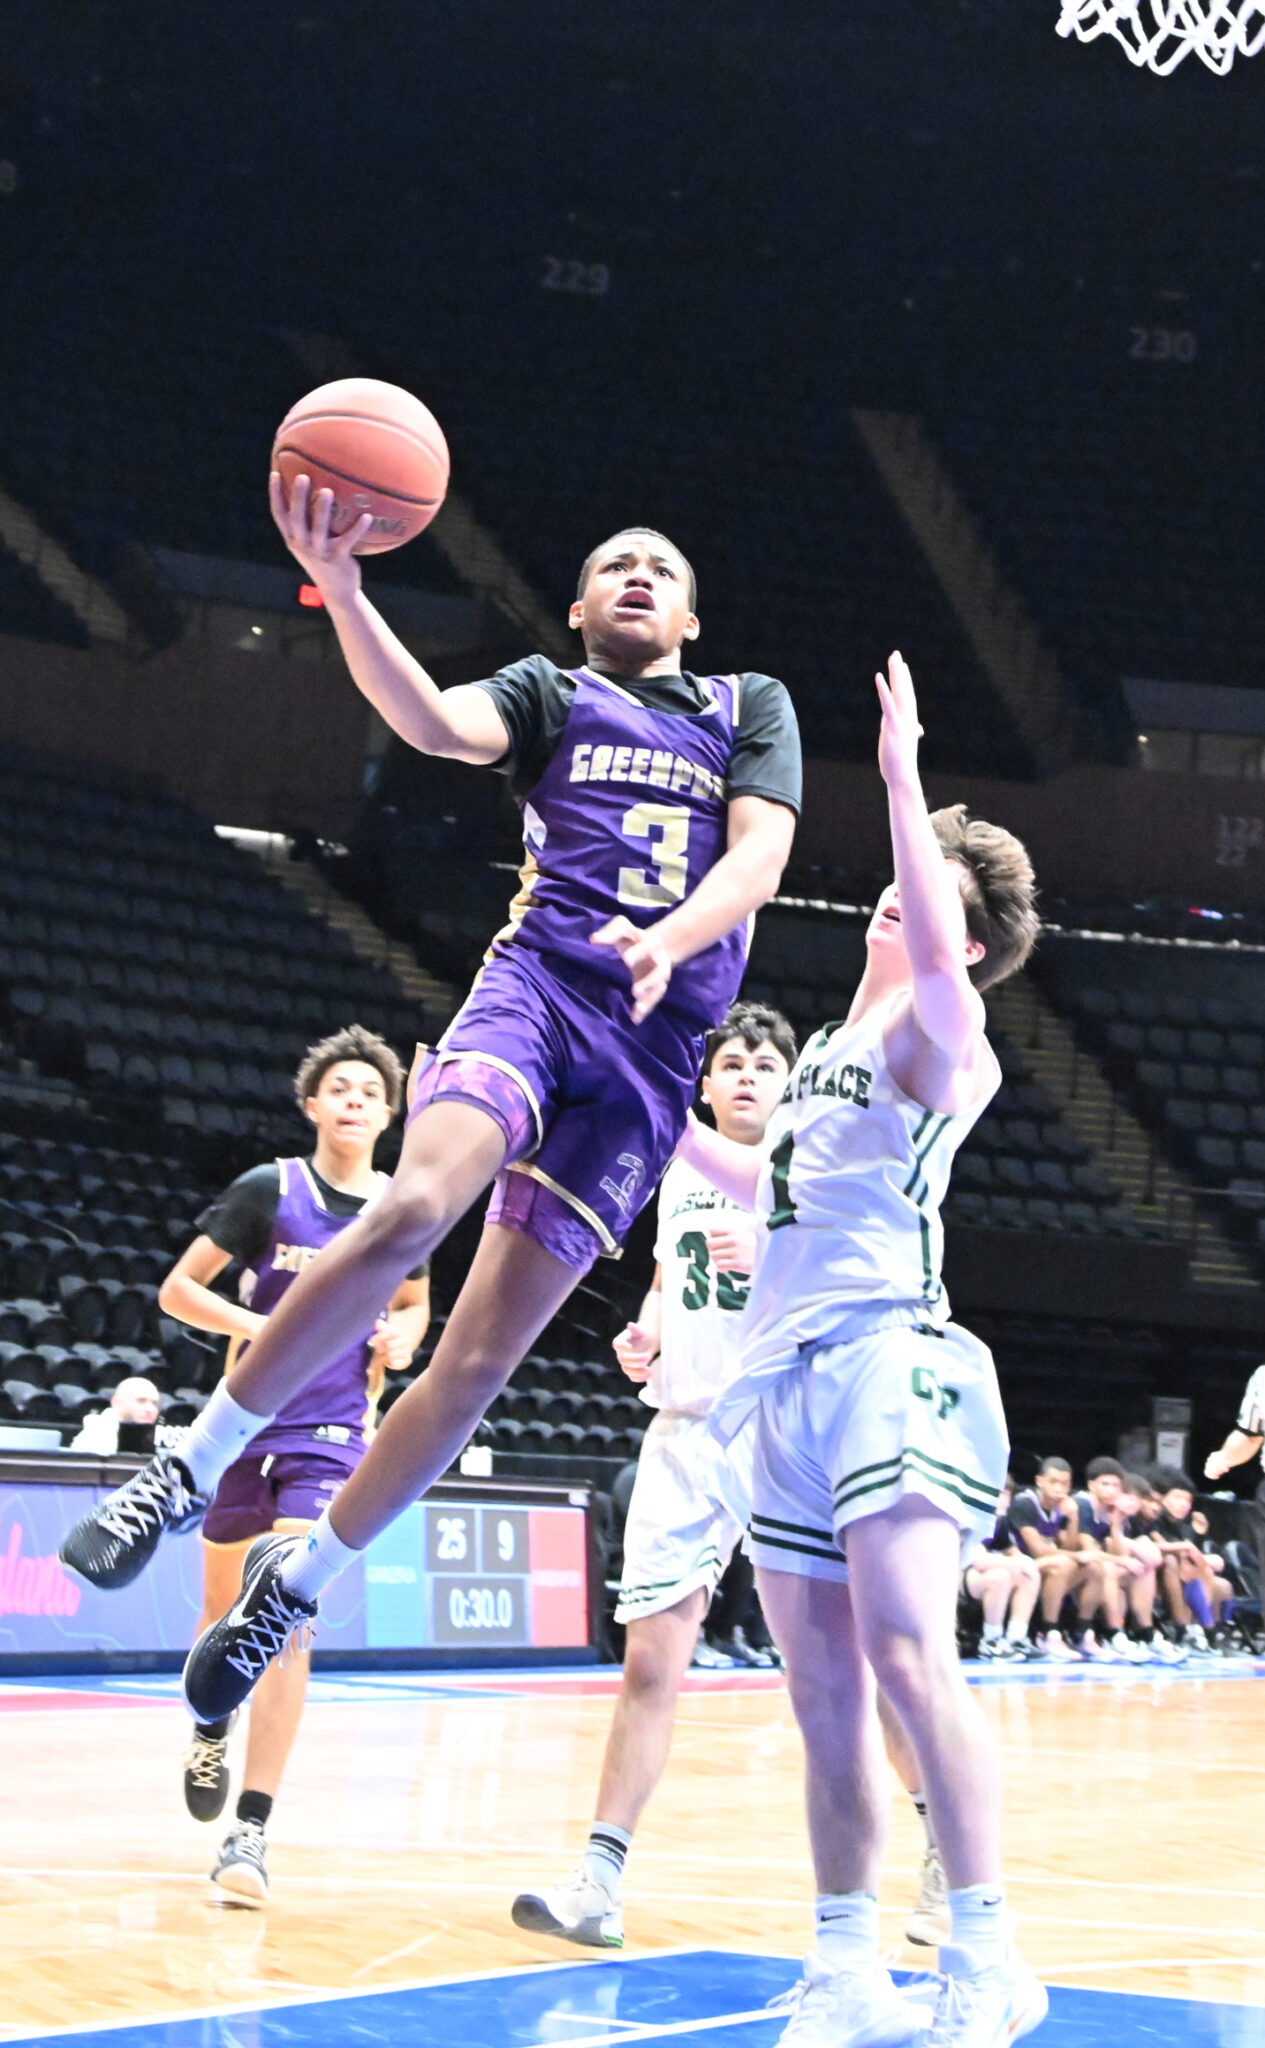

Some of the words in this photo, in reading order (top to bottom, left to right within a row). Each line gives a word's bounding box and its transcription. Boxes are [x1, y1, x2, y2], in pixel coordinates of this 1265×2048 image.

[541, 255, 609, 296] 229
[1128, 327, 1197, 363] 230
[617, 803, 691, 908] 3
[797, 1064, 872, 1110] PLACE
[766, 1129, 798, 1231] 1
[911, 1366, 961, 1421] CP
[437, 1517, 467, 1560] 25
[497, 1519, 515, 1561] 9
[449, 1588, 513, 1629] 0:30.0
